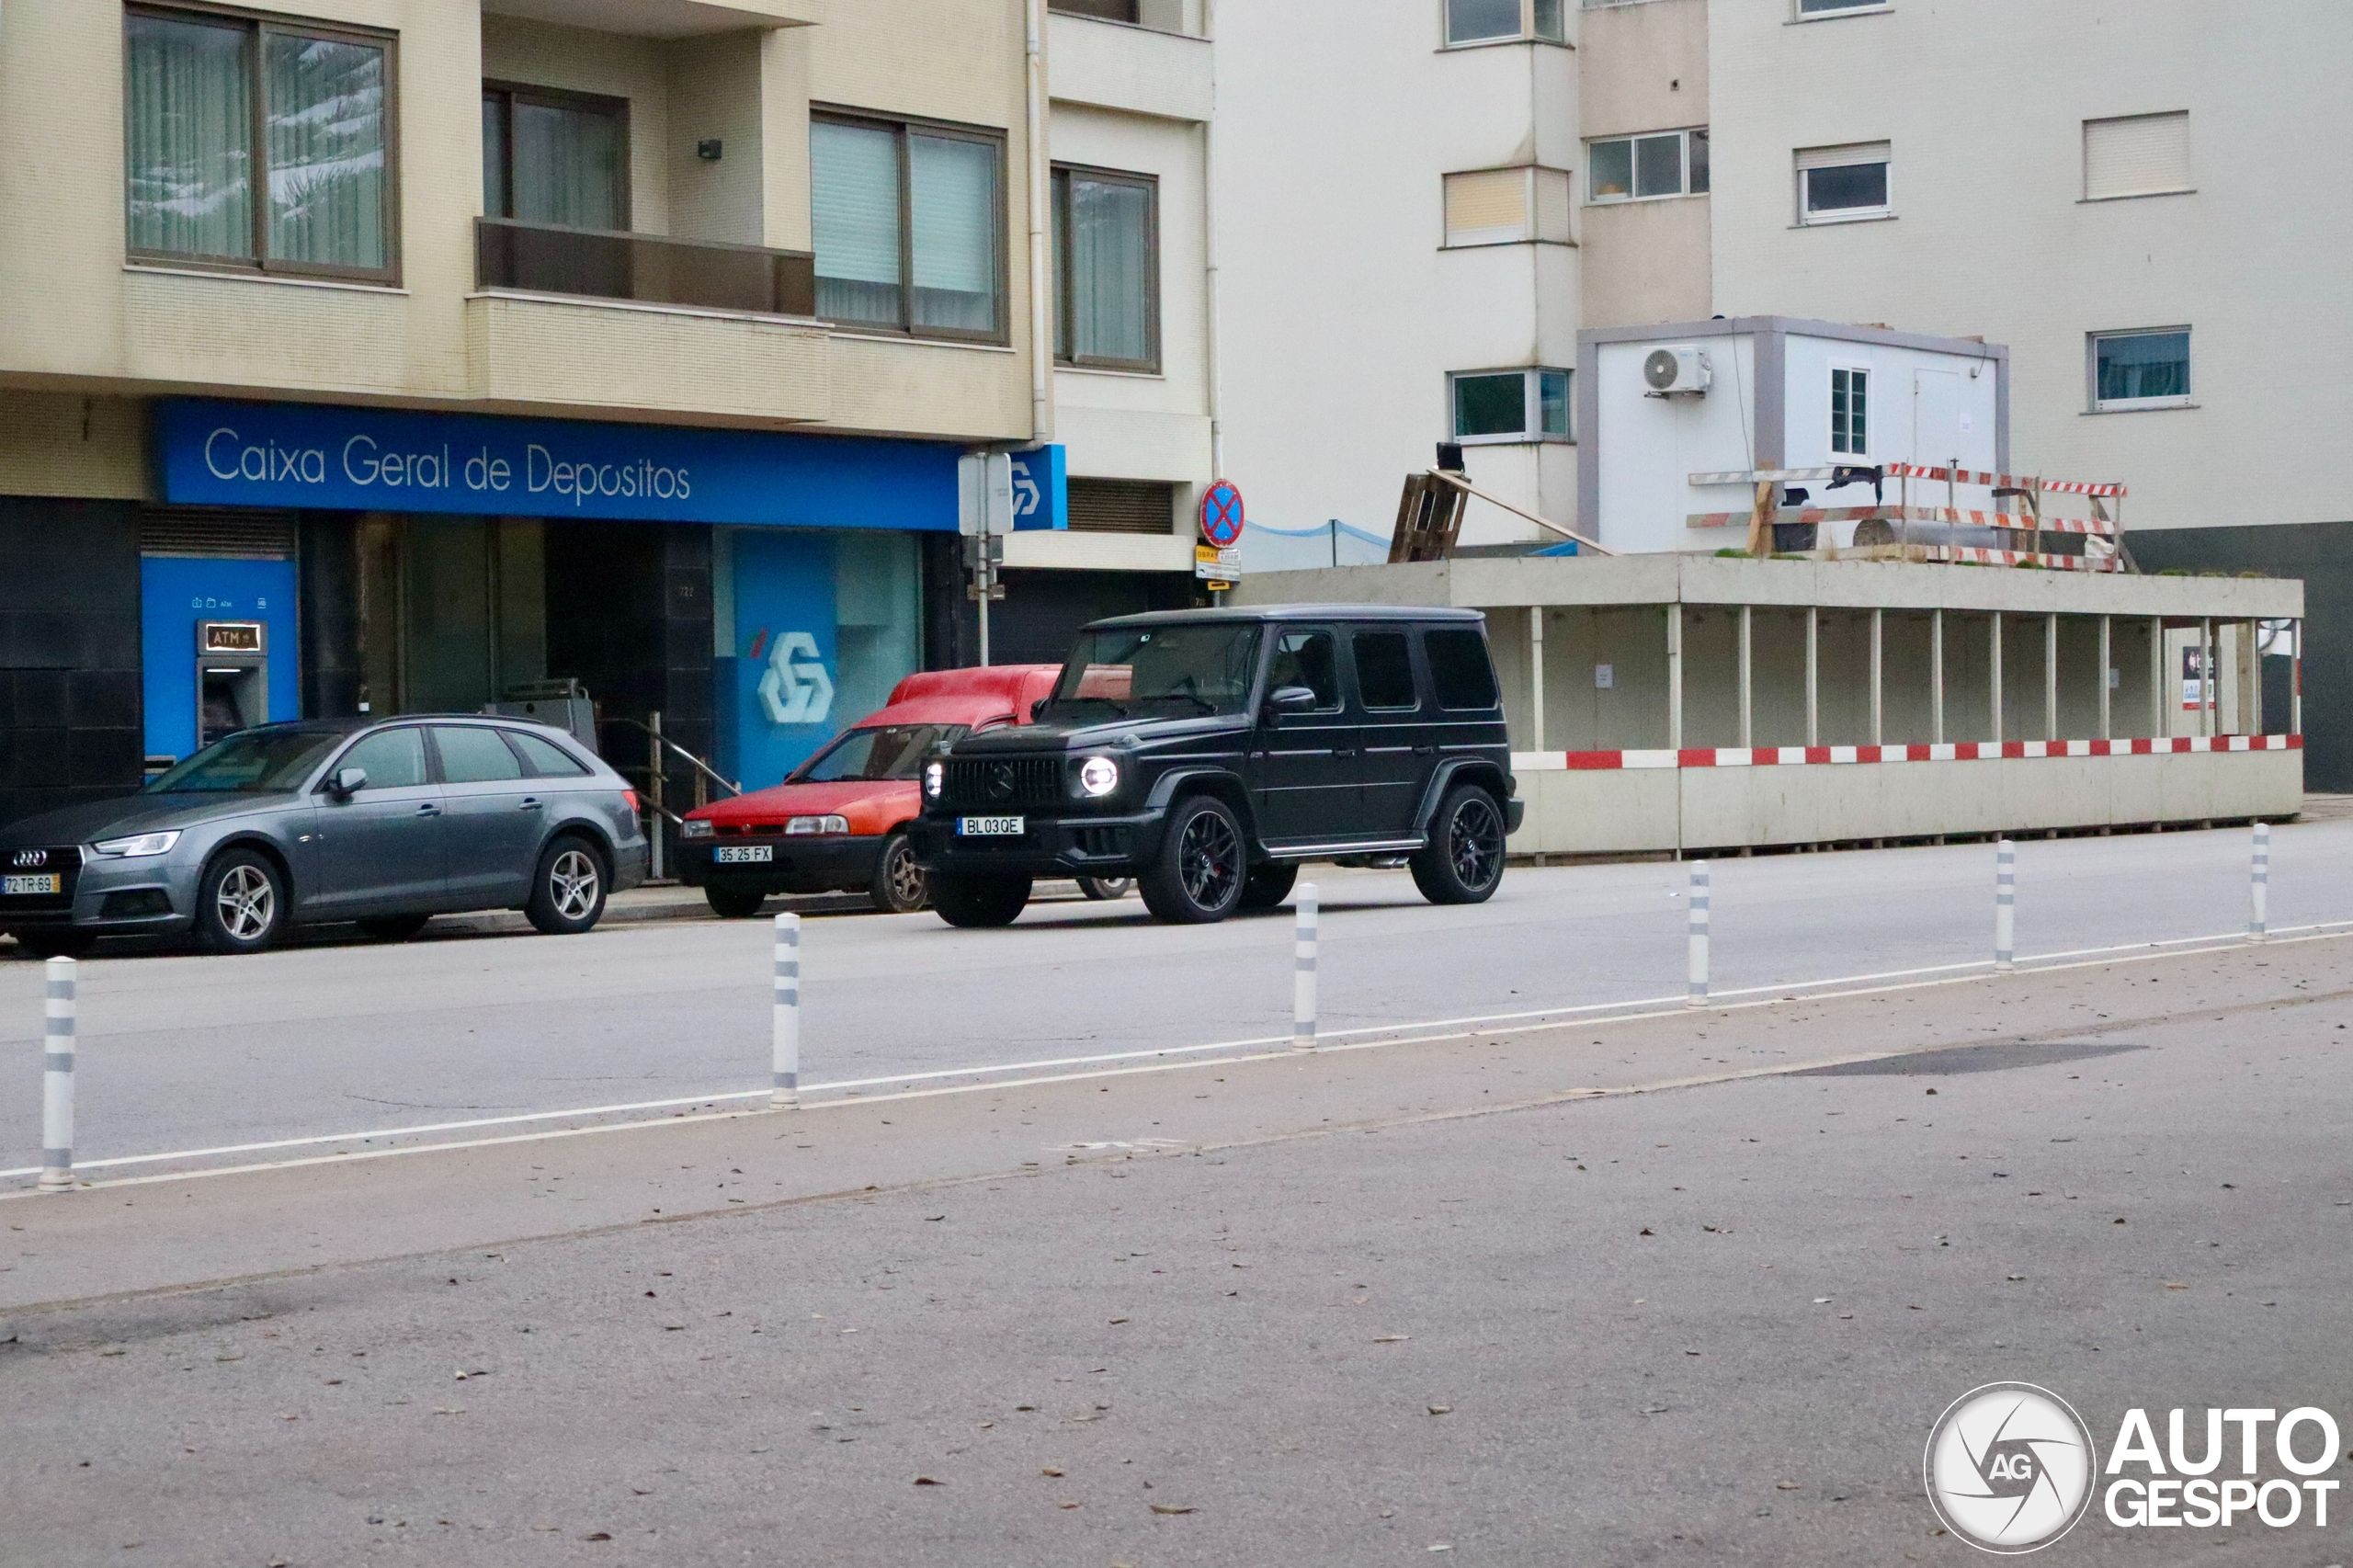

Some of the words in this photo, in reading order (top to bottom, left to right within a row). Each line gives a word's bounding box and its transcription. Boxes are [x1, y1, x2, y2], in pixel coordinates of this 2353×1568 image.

[204, 427, 324, 483] Caixa
[343, 435, 449, 488] Geral
[465, 447, 510, 491] de
[528, 444, 690, 506] Depositos
[213, 631, 239, 644] ATM
[967, 819, 1018, 834] BL03QE
